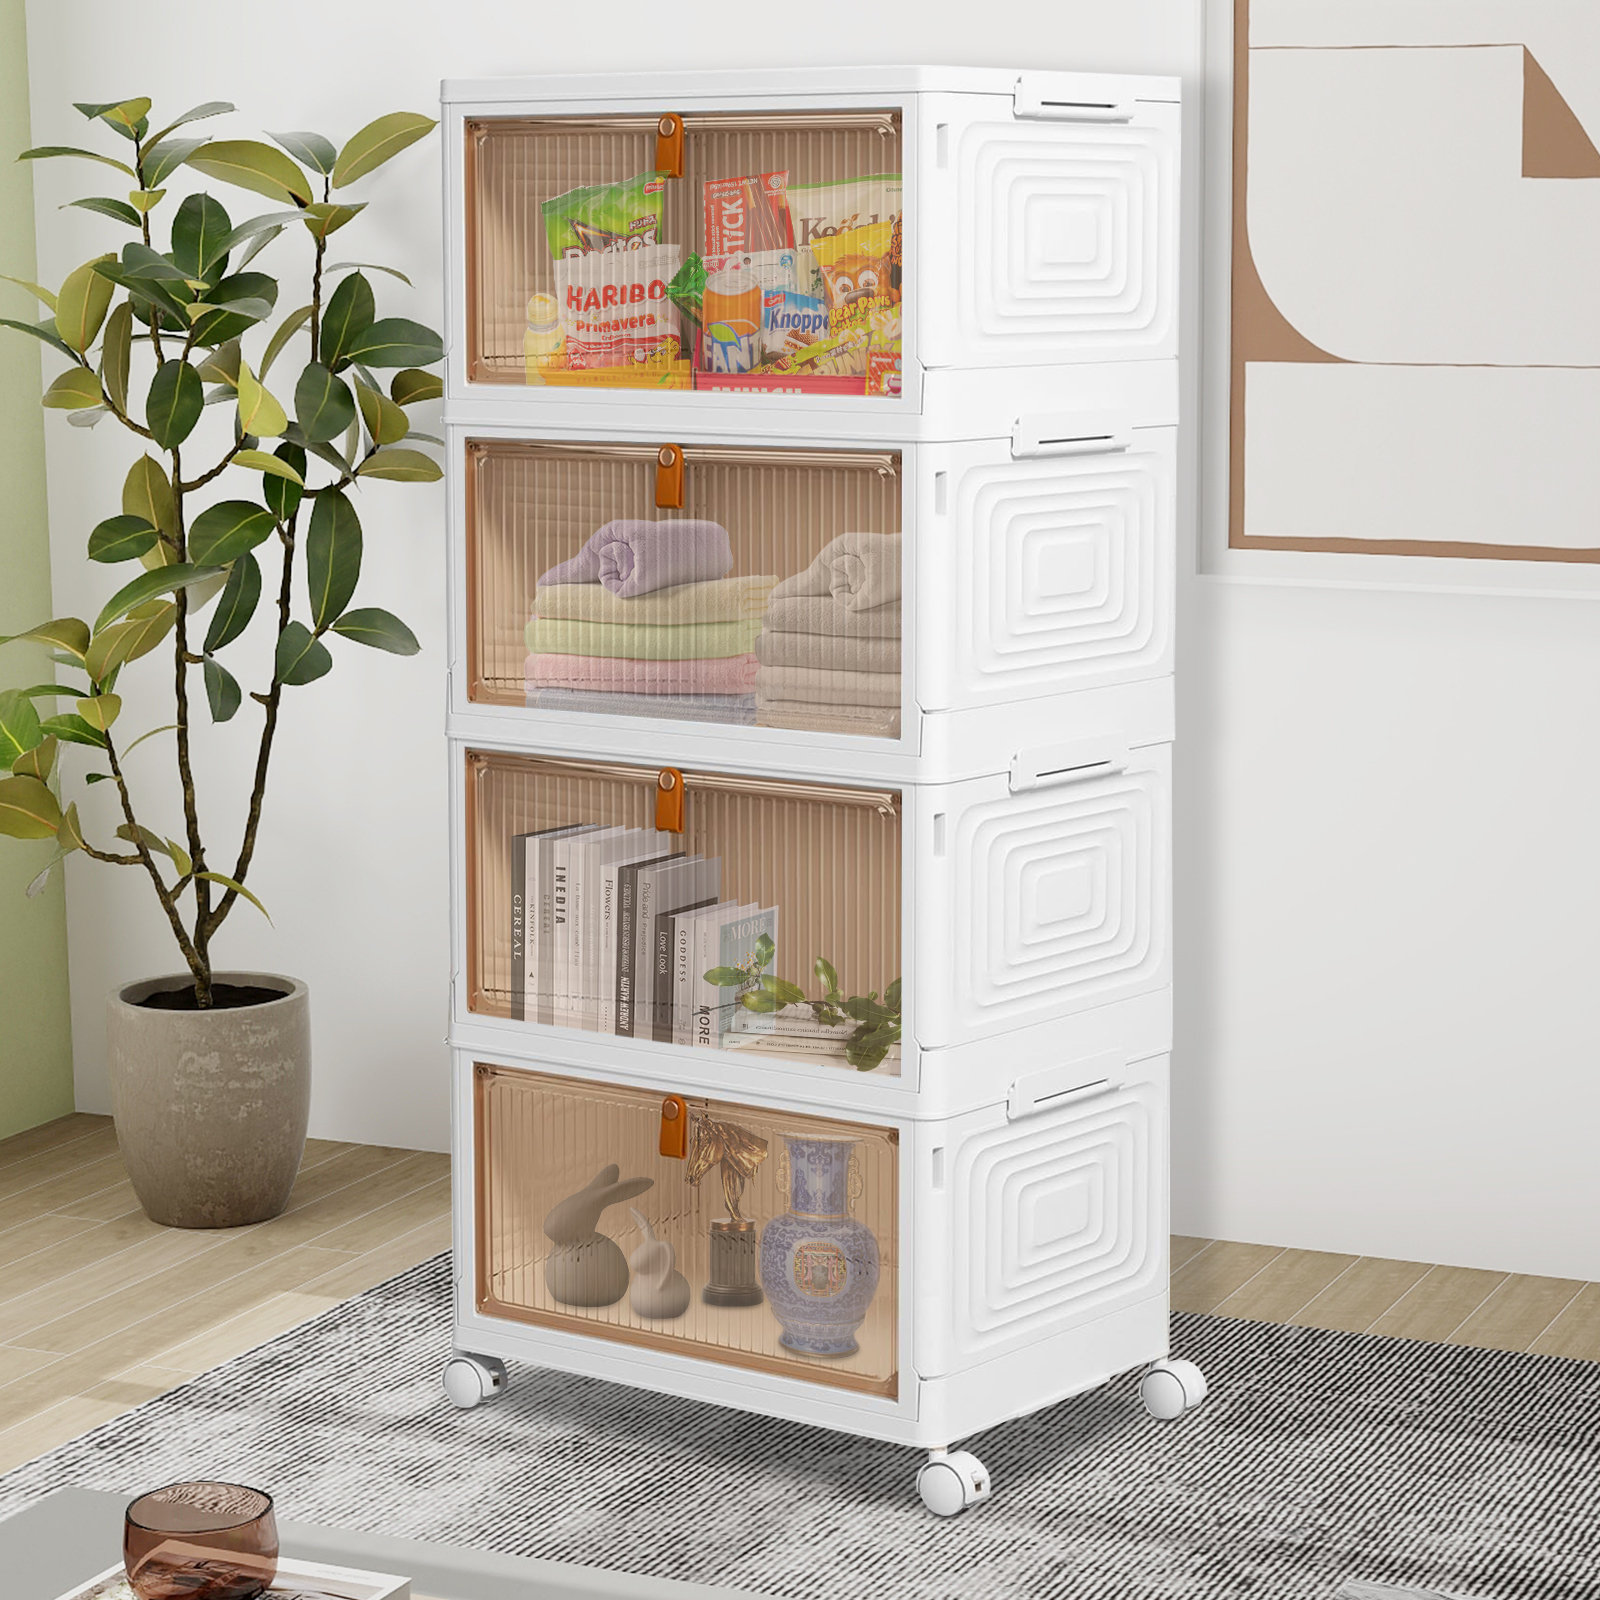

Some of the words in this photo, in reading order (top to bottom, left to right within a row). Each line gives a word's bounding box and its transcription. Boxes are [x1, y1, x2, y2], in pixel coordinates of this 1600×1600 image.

[722, 198, 745, 256] TICK
[566, 279, 667, 312] HARIBO
[576, 313, 656, 333] Primavera
[829, 304, 857, 327] Bear
[555, 866, 566, 924] INEDIA
[604, 879, 613, 920] Flowers
[642, 882, 651, 902] Pride
[641, 903, 650, 919] and
[513, 894, 522, 960] CEREAL
[659, 931, 668, 951] Love
[731, 917, 767, 940] MORE
[659, 954, 668, 975] Look
[679, 930, 687, 983] GODDESS
[619, 1002, 629, 1031] ANDREW
[699, 1005, 710, 1045] MORE
